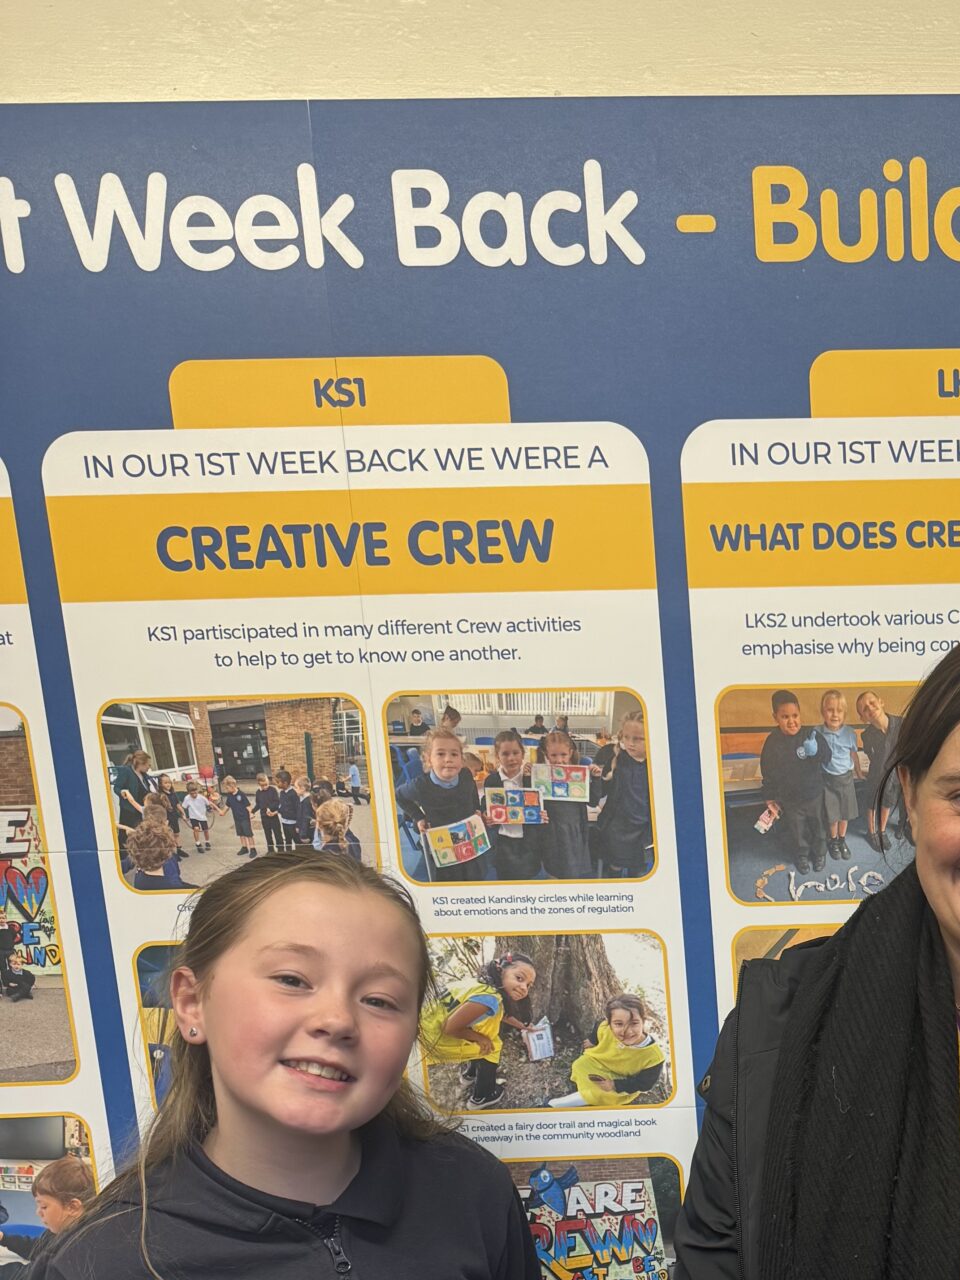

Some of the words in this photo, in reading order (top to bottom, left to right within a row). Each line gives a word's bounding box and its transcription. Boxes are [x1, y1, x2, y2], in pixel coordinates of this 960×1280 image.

[55, 163, 364, 272] Week
[391, 159, 645, 267] Back
[676, 215, 716, 232] -
[314, 377, 366, 408] KS1
[84, 455, 113, 478] IN
[123, 454, 189, 477] OUR
[195, 453, 240, 476] 1ST
[247, 451, 339, 474] WEEK
[346, 449, 428, 472] BACK
[434, 448, 484, 470] WE
[491, 446, 580, 470] WERE
[588, 446, 608, 468] A
[732, 443, 758, 465] IN
[768, 442, 831, 465] OUR
[838, 441, 881, 464] 1ST
[156, 522, 390, 572] CREATIVE
[408, 519, 554, 566] CREW
[813, 521, 897, 550] DOES
[148, 626, 177, 641] KS1
[183, 622, 297, 644] partiscipated
[303, 622, 319, 637] in
[324, 625, 373, 639] many
[378, 620, 453, 635] different
[457, 619, 502, 633] Crew
[507, 616, 581, 632] activities
[746, 613, 787, 628] LKS2
[792, 611, 880, 627] undertook
[885, 610, 943, 625] various
[215, 653, 232, 667] to
[238, 651, 276, 669] help
[281, 652, 299, 665] to
[303, 651, 332, 668] get
[336, 650, 354, 663] to
[359, 648, 411, 663] know
[414, 650, 444, 661] one
[450, 645, 521, 661] another.
[742, 639, 834, 658] emphasise
[838, 638, 873, 657] why
[879, 637, 925, 656] being
[433, 896, 448, 905] KS1
[451, 895, 486, 905] created
[488, 895, 536, 905] Kandinsky
[538, 893, 567, 903] circles
[569, 893, 594, 903] while
[596, 893, 633, 903] learning
[434, 907, 462, 917] about
[464, 906, 508, 916] emotions
[510, 905, 528, 915] and
[530, 905, 545, 915] the
[548, 906, 575, 915] zones
[588, 905, 634, 915] regulation
[471, 1123, 505, 1133] created
[515, 1122, 534, 1132] fairy
[536, 1121, 557, 1130] door
[559, 1120, 575, 1130] trail
[578, 1120, 595, 1129] and
[597, 1119, 632, 1129] magical
[635, 1117, 657, 1127] book
[526, 1132, 540, 1141] the
[543, 1131, 594, 1141] community
[596, 1129, 641, 1139] woodland
[566, 1181, 646, 1218] ARE
[632, 1255, 655, 1274] BE
